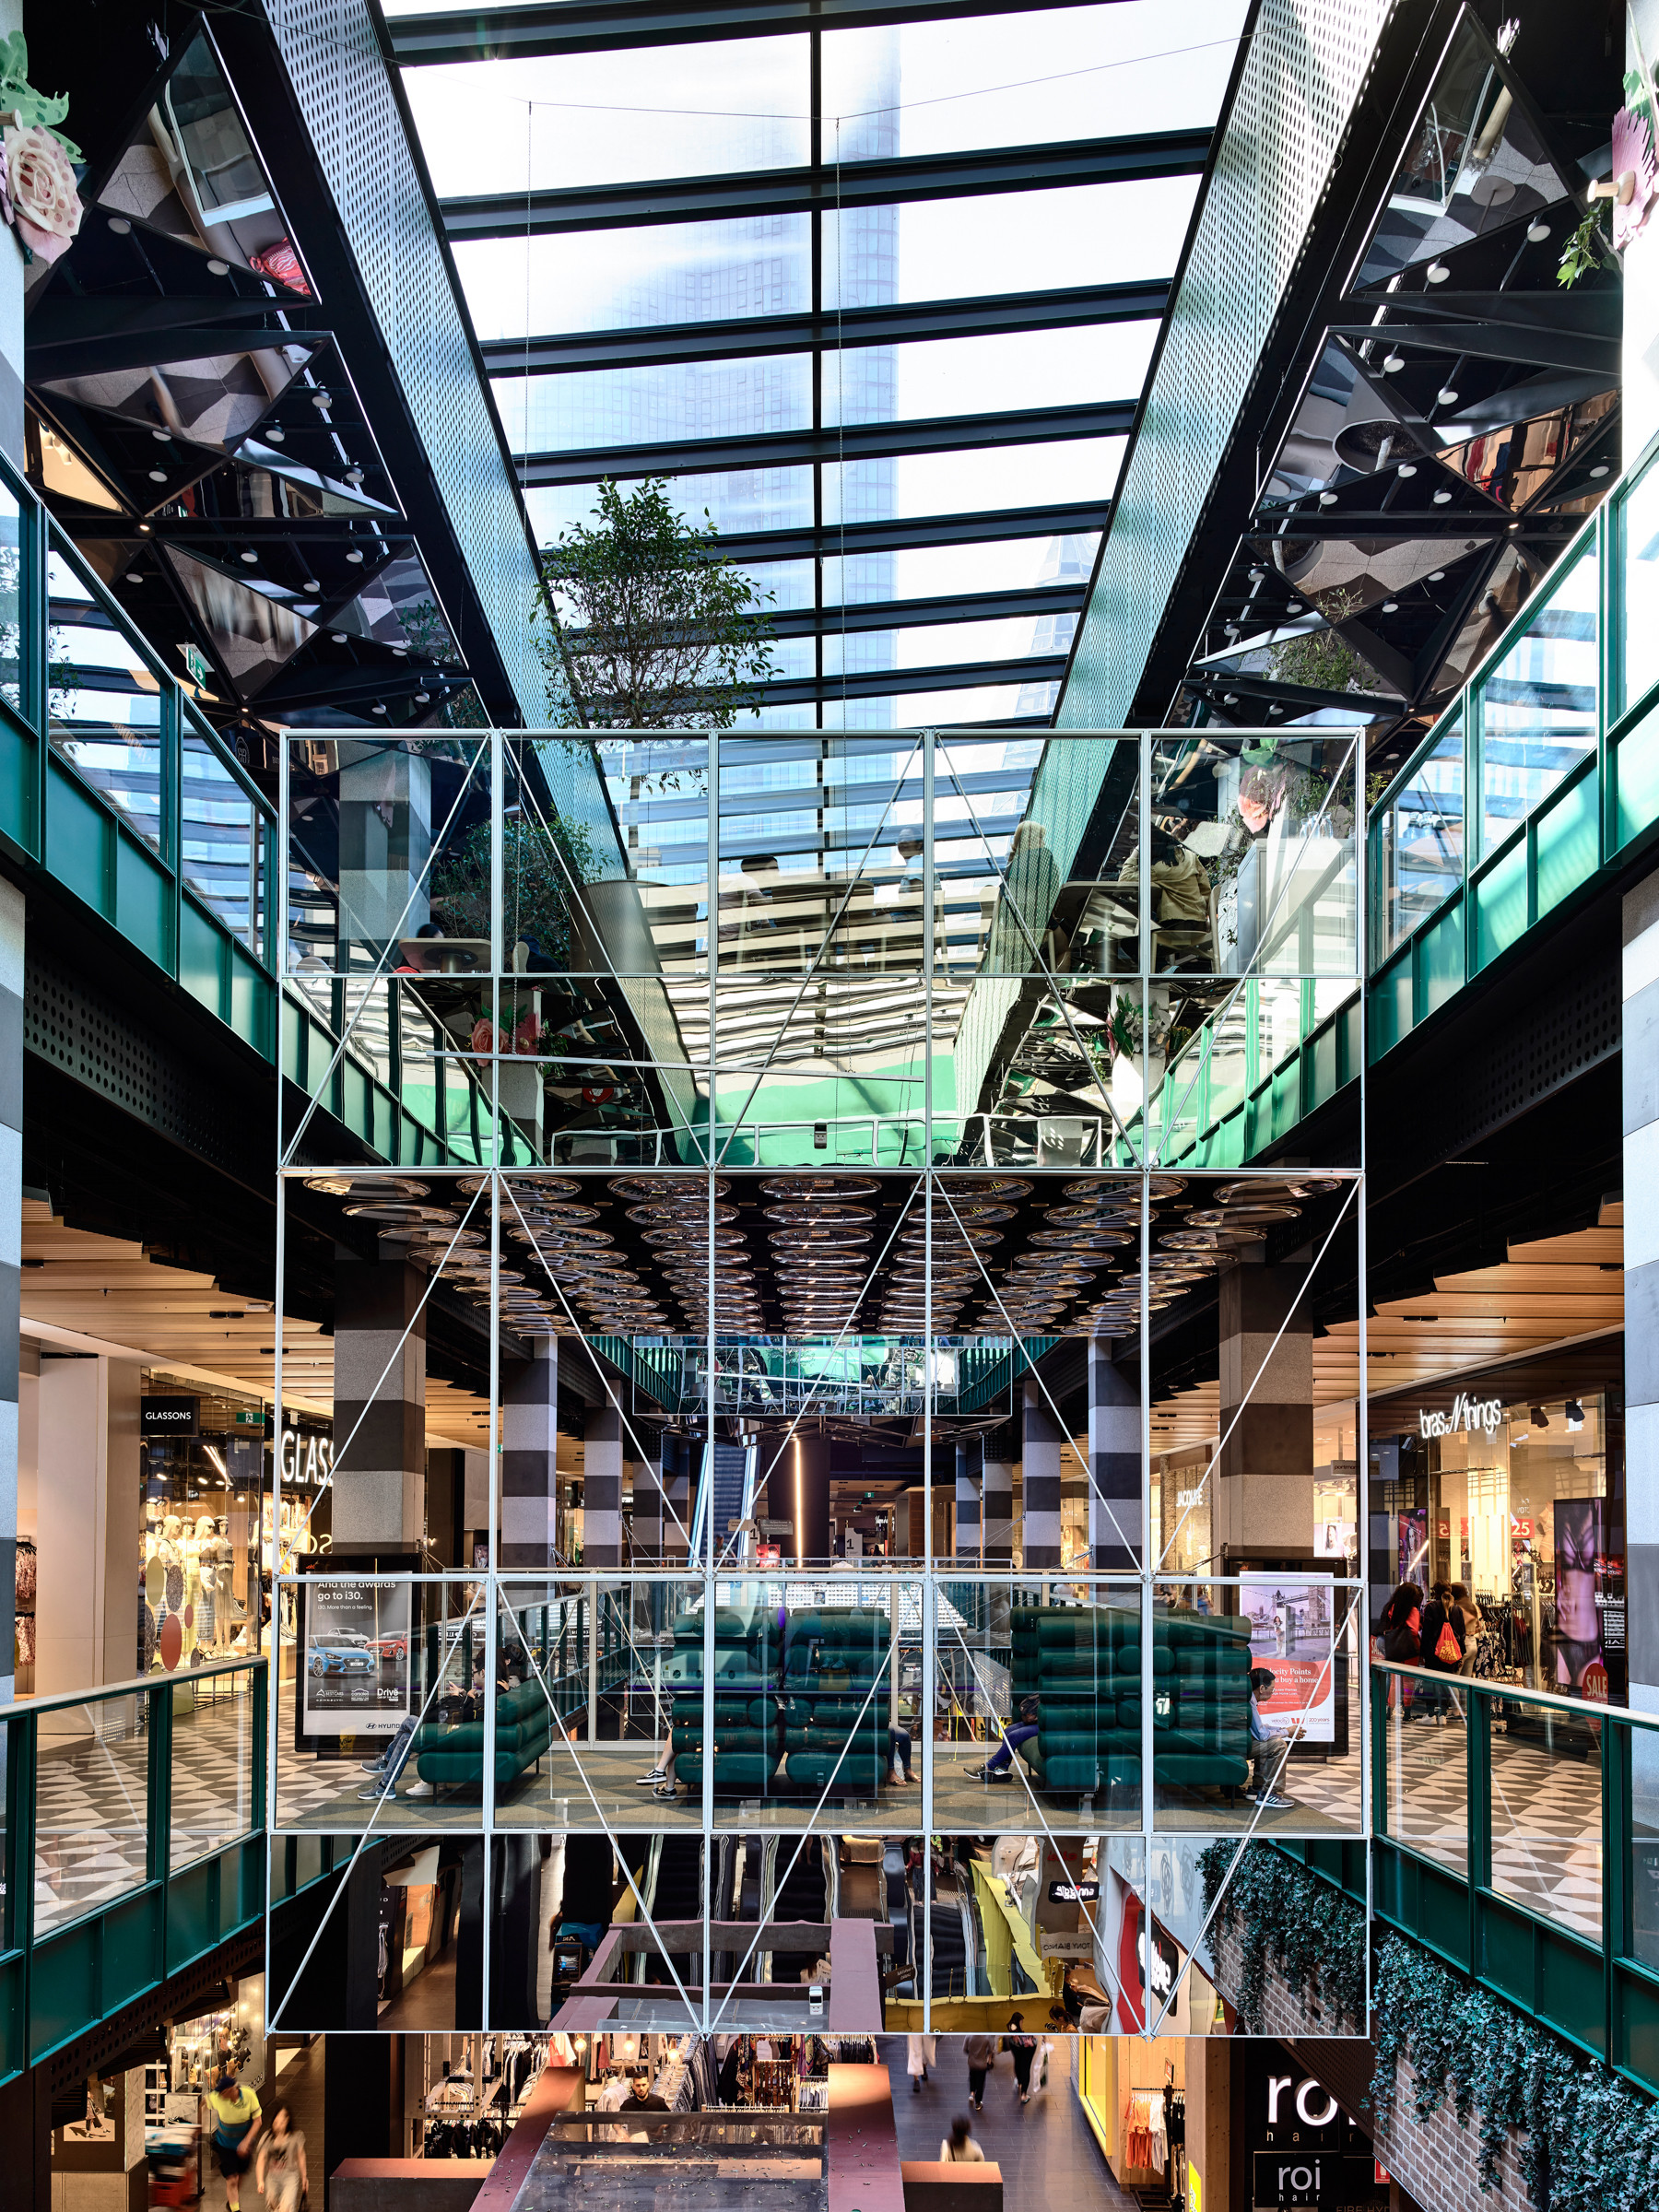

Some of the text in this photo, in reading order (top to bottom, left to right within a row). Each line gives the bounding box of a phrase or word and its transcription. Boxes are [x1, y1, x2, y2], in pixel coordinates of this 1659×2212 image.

[145, 1411, 192, 1420] GLASSONS
[1463, 1396, 1501, 1435] things
[317, 1591, 363, 1602] go to i30.
[1271, 1668, 1288, 1677] locity
[377, 1688, 399, 1696] Drive
[1586, 1675, 1607, 1699] SALE
[1268, 2076, 1357, 2126] ro
[1278, 2159, 1321, 2191] roi
[1279, 2194, 1320, 2202] hair
